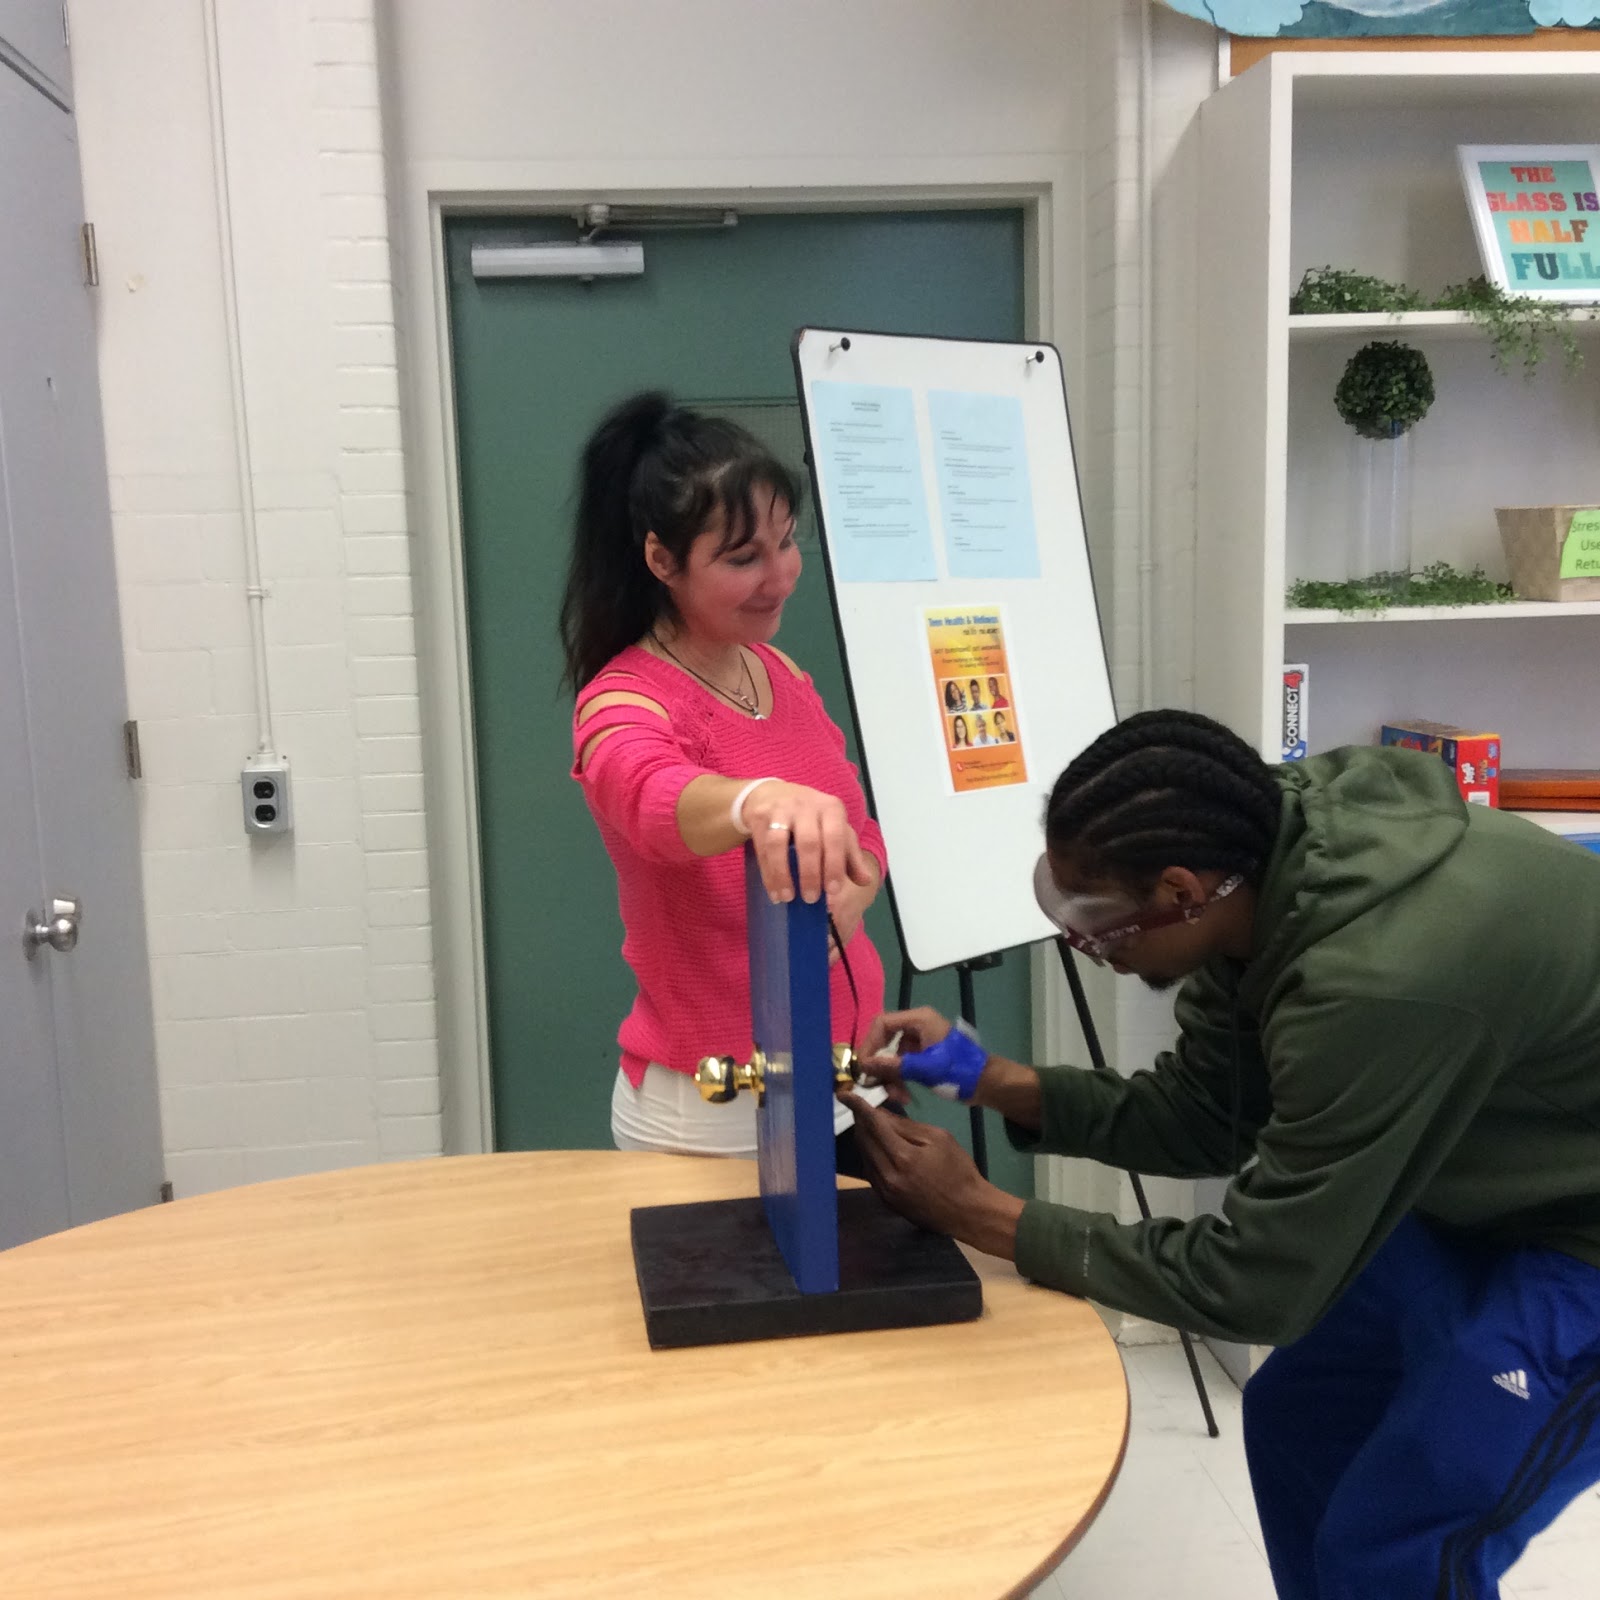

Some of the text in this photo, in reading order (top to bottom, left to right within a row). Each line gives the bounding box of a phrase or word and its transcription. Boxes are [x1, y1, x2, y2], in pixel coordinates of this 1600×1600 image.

[1510, 166, 1556, 183] THE
[1486, 191, 1600, 213] GLASS IS
[1508, 219, 1589, 244] HALF
[1511, 252, 1600, 280] FULL
[1286, 687, 1299, 748] CONNECT
